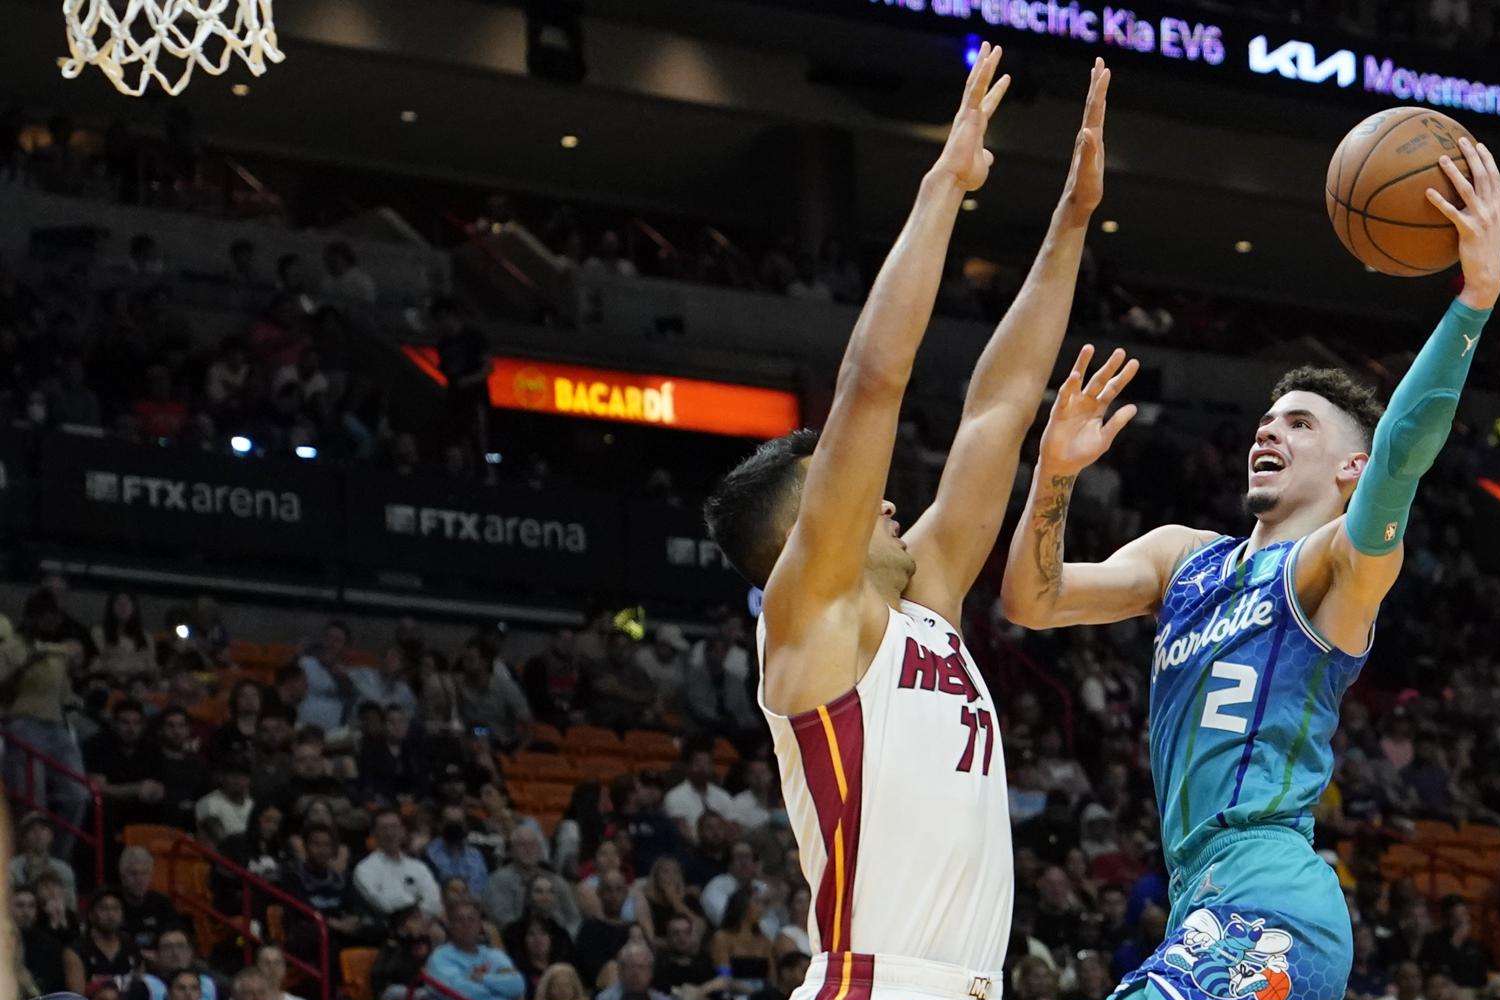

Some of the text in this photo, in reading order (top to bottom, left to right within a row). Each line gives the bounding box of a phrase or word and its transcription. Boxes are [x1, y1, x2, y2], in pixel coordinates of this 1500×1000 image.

[1103, 5, 1155, 53] Kia
[1159, 16, 1226, 65] EV6
[1200, 661, 1258, 733] 2
[956, 705, 994, 776] 77
